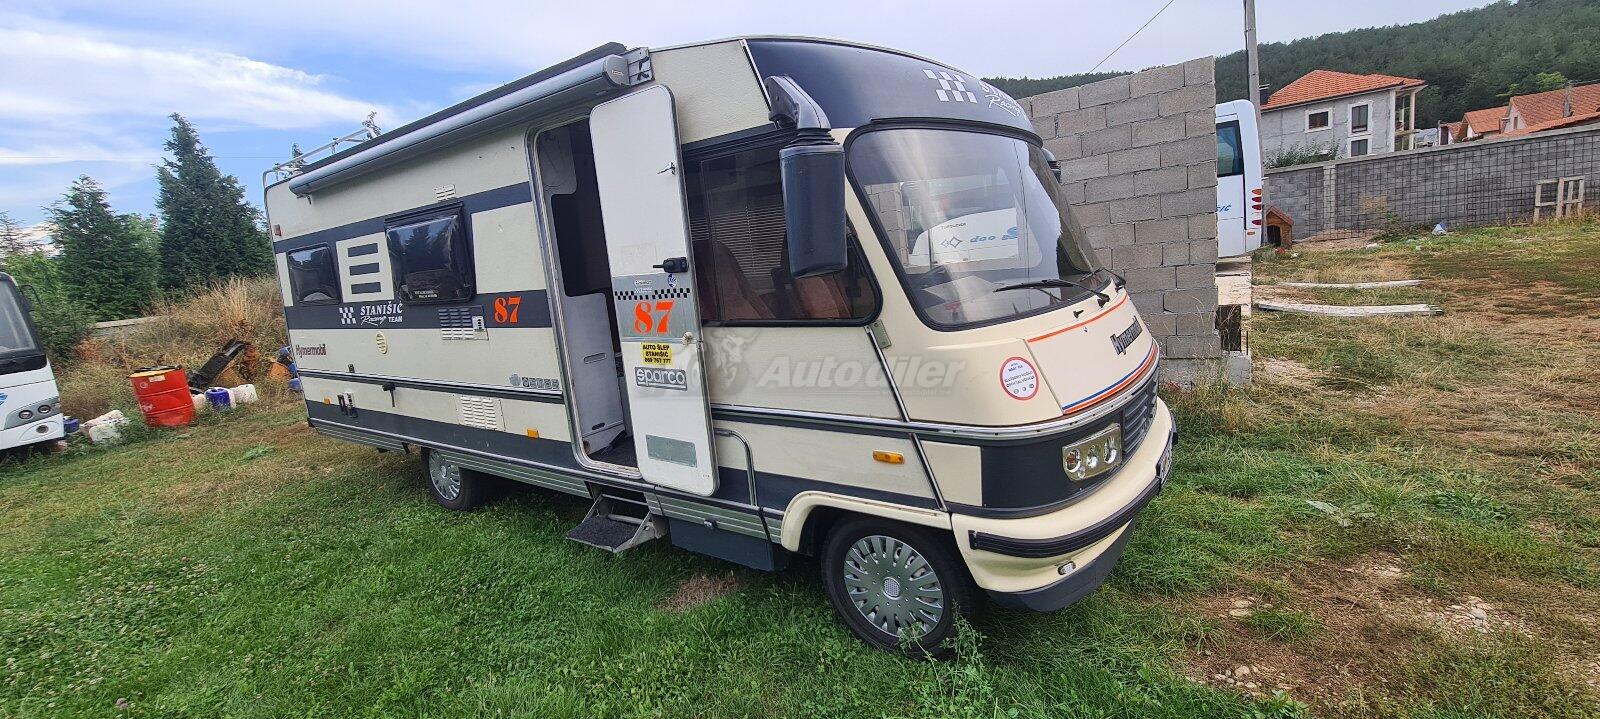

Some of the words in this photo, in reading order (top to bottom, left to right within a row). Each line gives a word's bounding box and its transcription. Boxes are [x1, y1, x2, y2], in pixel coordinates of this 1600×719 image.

[360, 301, 403, 316] STANIŠIĆ
[494, 296, 521, 323] 87
[634, 300, 675, 334] 87
[636, 368, 686, 386] sparco
